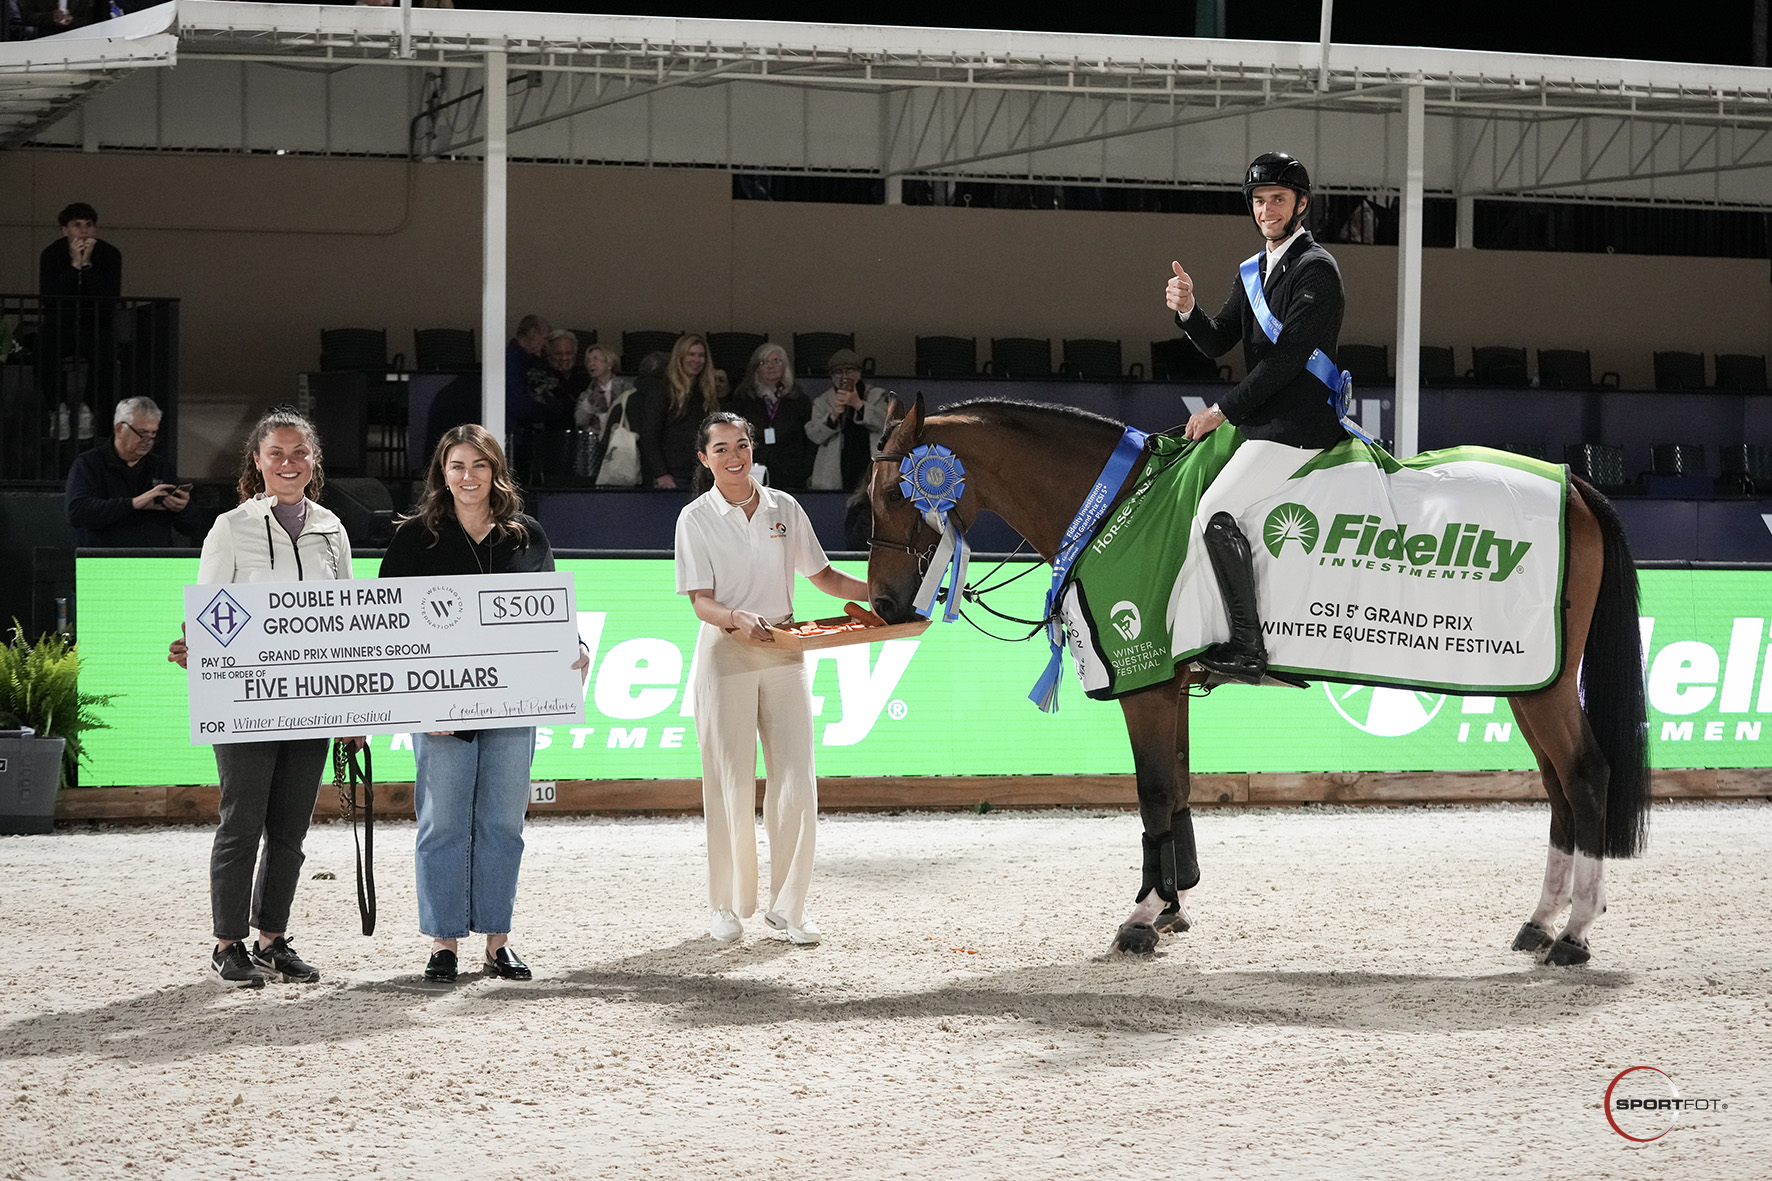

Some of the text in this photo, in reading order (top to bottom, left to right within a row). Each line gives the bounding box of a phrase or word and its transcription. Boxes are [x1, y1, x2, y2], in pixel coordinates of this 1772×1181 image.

[1066, 515, 1083, 538] Fidelity
[1079, 482, 1103, 517] Investments
[1079, 513, 1092, 534] Grand
[1089, 502, 1099, 518] Prix
[1095, 492, 1105, 504] CSI
[1095, 503, 1108, 519] Place
[1319, 557, 1483, 580] INVESTMENTS
[269, 588, 402, 609] DOUBLE H FARM
[426, 585, 464, 613] WELLINGTON
[493, 594, 555, 619] $500
[263, 612, 410, 635] GROOMS AWARD
[420, 597, 462, 630] INTERNATIONAL
[1309, 602, 1340, 618] CSI
[1364, 606, 1428, 629] GRAND
[1433, 615, 1474, 632] PRIX
[1260, 620, 1525, 655] WINTER EQUESTRIAN FESTIVAL
[258, 643, 431, 662] GRAND PRIX WINNER'S GROOM
[1111, 646, 1167, 669] QUESTRIAN
[1113, 641, 1153, 658] WINTER
[201, 656, 236, 668] PAY TO
[1116, 659, 1160, 677] FESTIVAL
[201, 669, 266, 680] TO THE ORDER OF
[245, 666, 499, 699] FIVE HUNDRED DOLLARS
[200, 710, 392, 734] FOR Winter Equestrian Festival
[535, 786, 554, 801] 10
